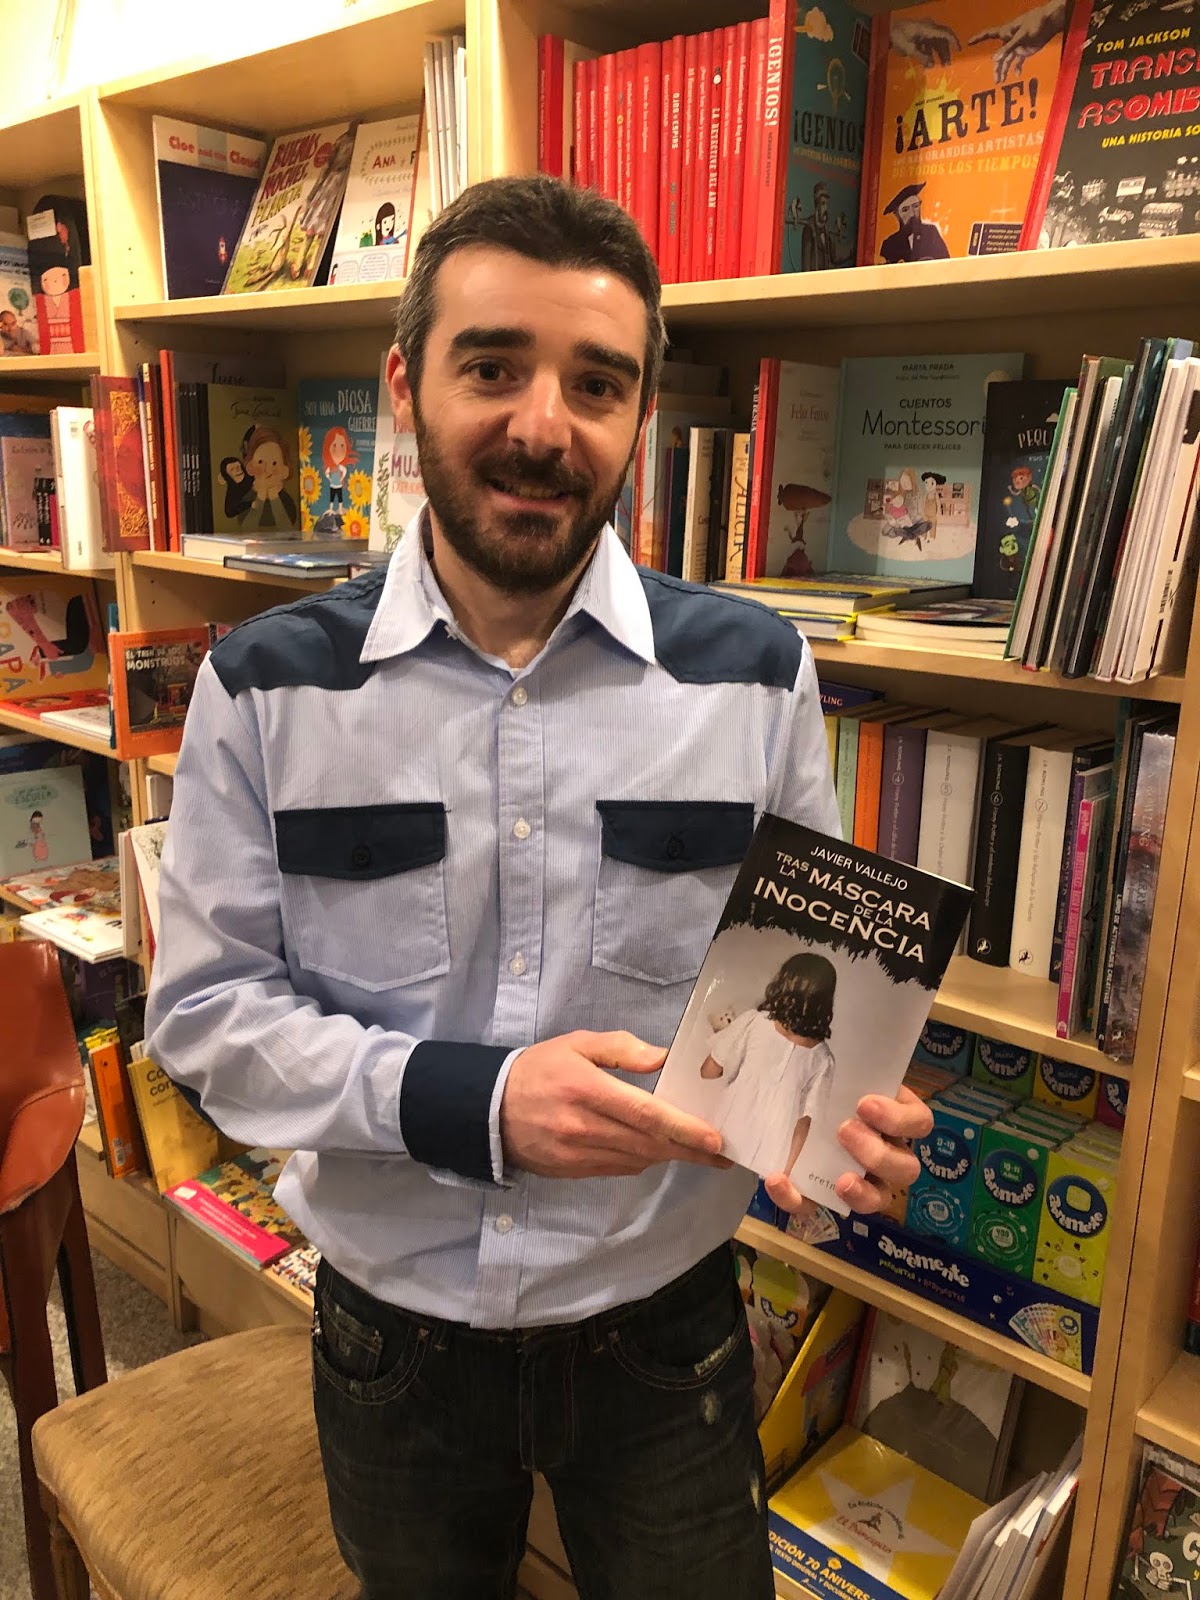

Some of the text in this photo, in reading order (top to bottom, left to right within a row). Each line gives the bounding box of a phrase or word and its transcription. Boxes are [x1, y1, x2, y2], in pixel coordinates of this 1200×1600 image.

[1097, 27, 1191, 54] TOM JACKSON
[1090, 47, 1200, 89] TRANS
[764, 37, 782, 127] ¡GENIOS!
[895, 77, 1039, 154] ¡ARTE!
[168, 135, 196, 154] Cloe
[710, 123, 719, 169] DETECTIVE
[976, 131, 1046, 154] ARTISTAS
[1101, 134, 1126, 149] UNA
[1128, 127, 1182, 144] HISTORIA
[372, 154, 397, 169] ANA
[976, 153, 1040, 173] TIEMPOS
[898, 398, 953, 410] CUENTOS
[861, 408, 987, 436] Montessori
[883, 441, 962, 451] PARA CRECER FELICES
[126, 649, 136, 660] EL
[1039, 770, 1048, 797] ROWLING
[775, 851, 810, 873] TRAS
[810, 845, 914, 891] JAVIER VALLEJO
[779, 864, 931, 932] LA MÁSCARA
[753, 876, 930, 964] INOCENCIA
[852, 903, 900, 928] DE LA
[1103, 893, 1123, 1004] LIBRO DE ACTIVIDADES CREATIVAS
[877, 1234, 971, 1288] abremente
[806, 1556, 822, 1571] 70
